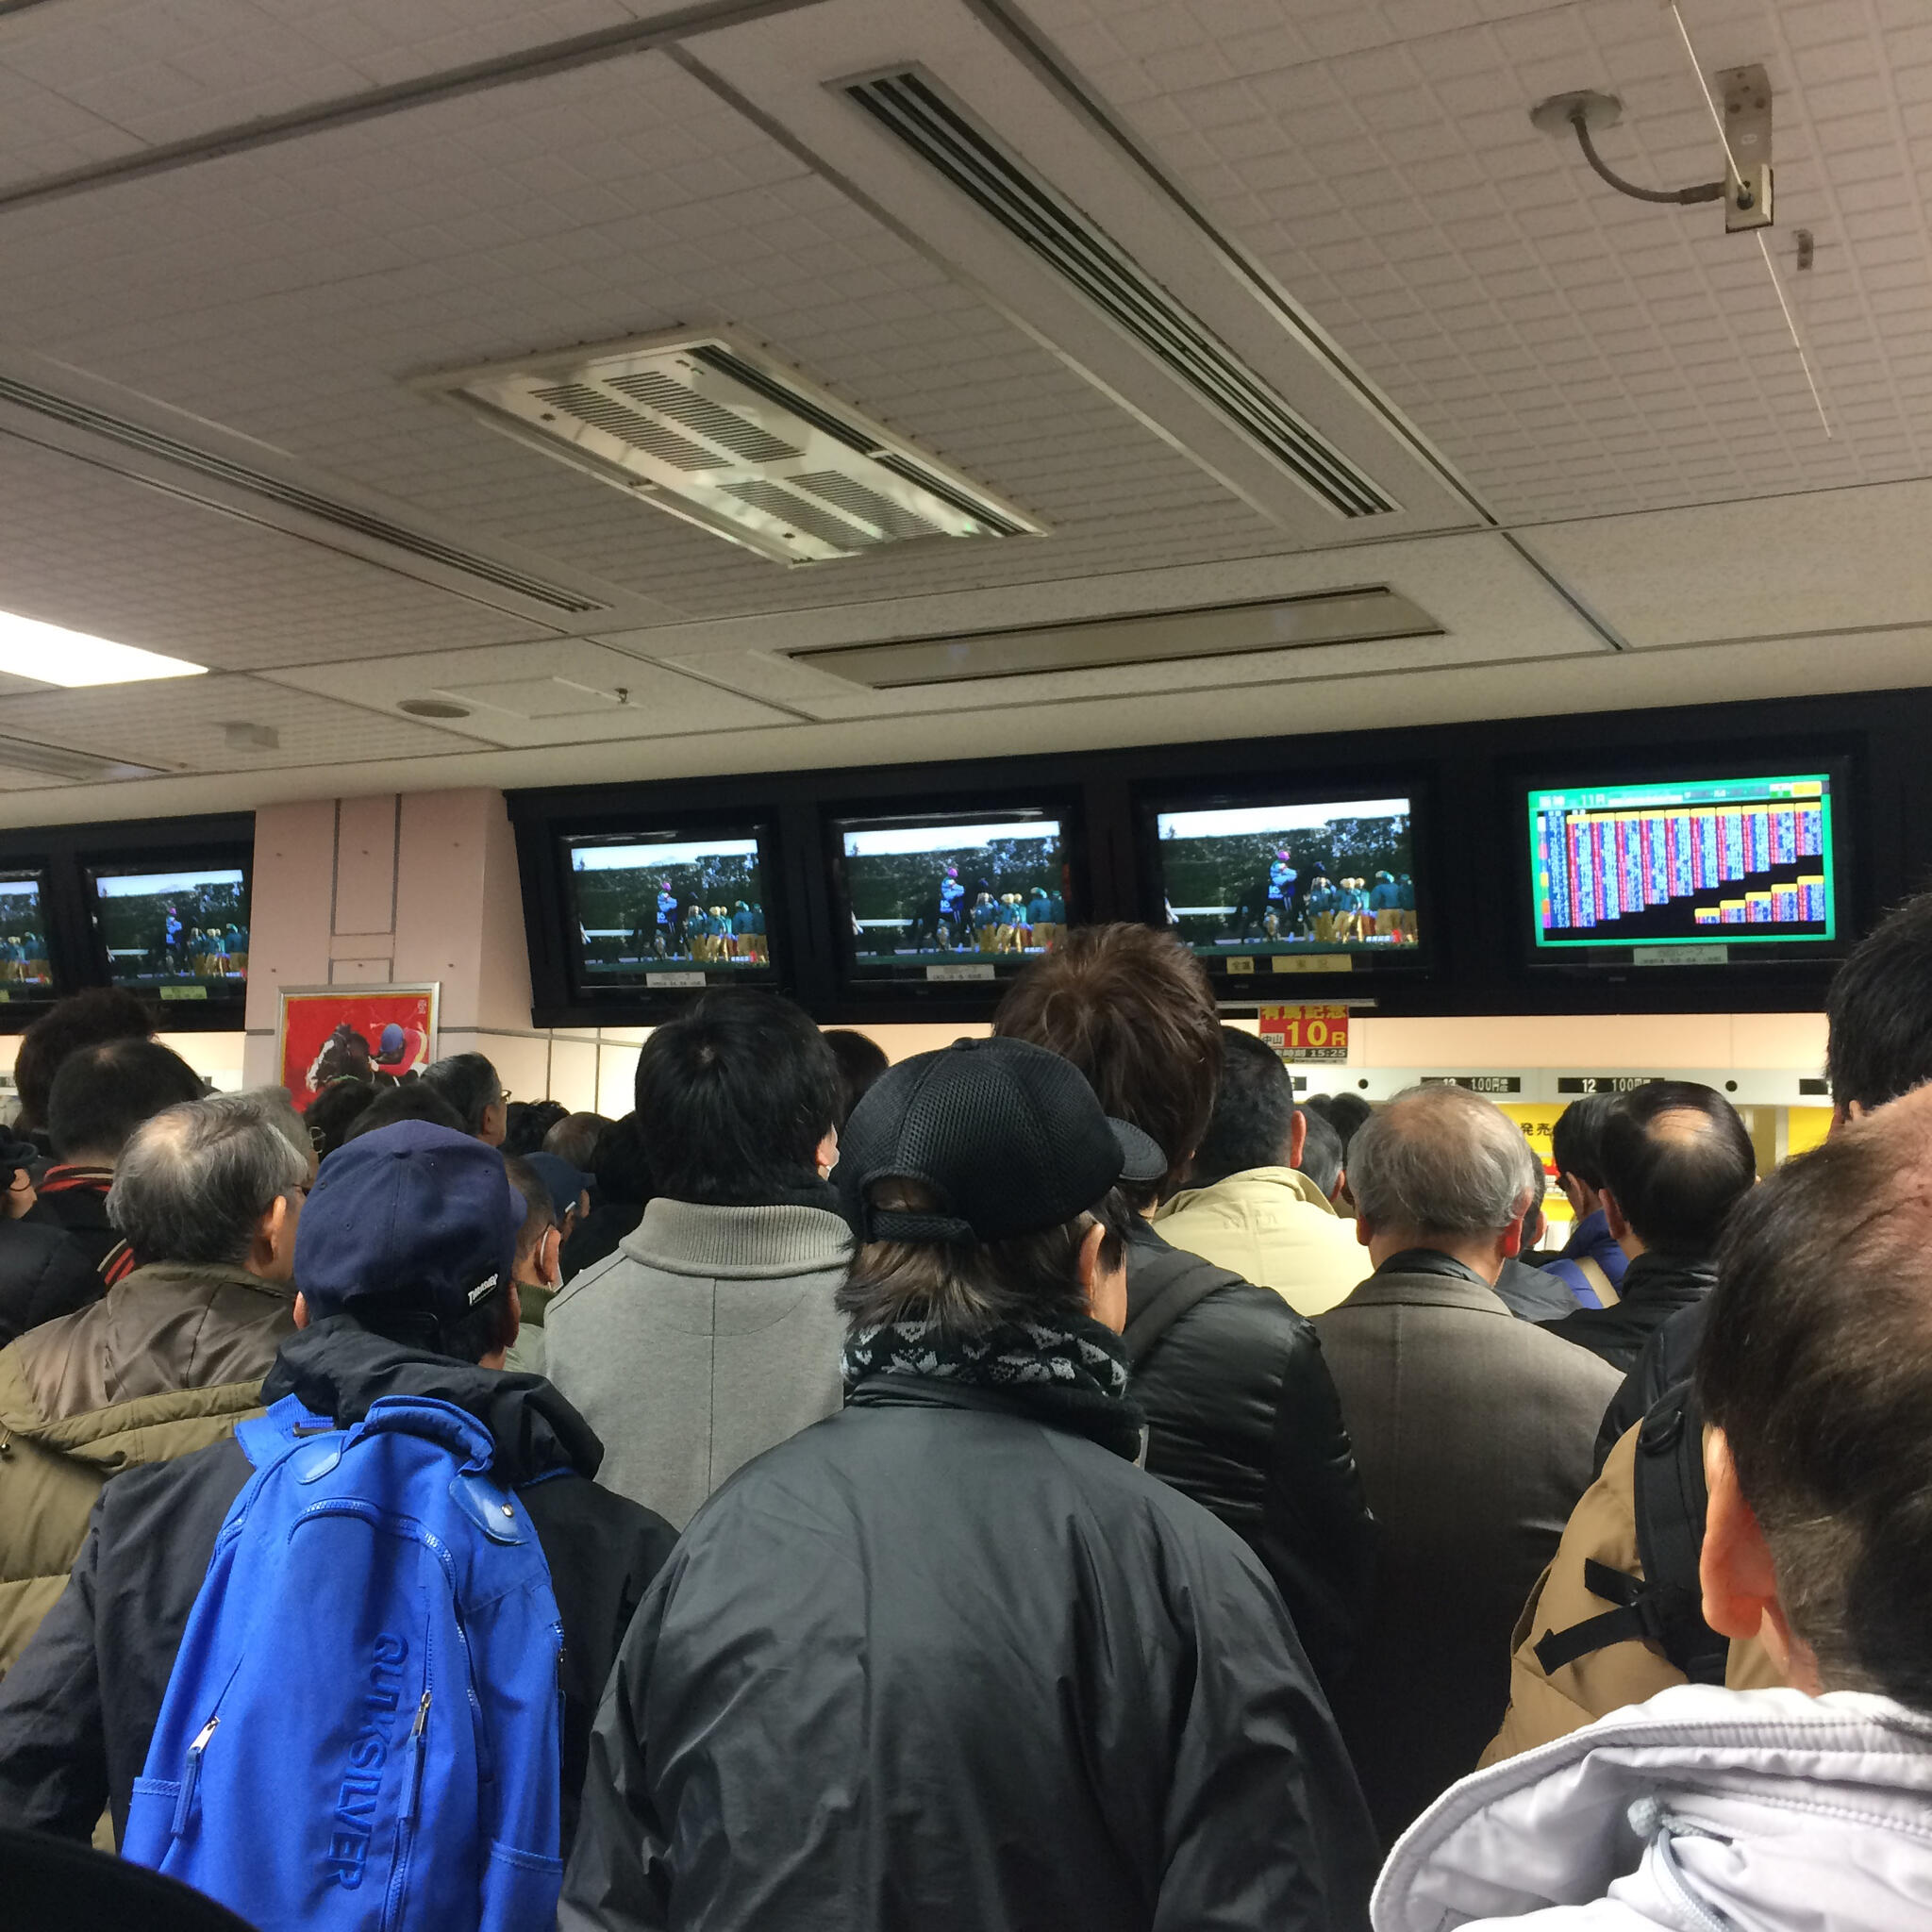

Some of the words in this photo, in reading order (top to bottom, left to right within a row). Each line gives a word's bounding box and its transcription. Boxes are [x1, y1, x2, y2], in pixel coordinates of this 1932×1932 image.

[1310, 1048, 1346, 1058] 15:25
[1582, 1078, 1597, 1093] 12
[326, 1632, 409, 1890] QUIKSILVER
